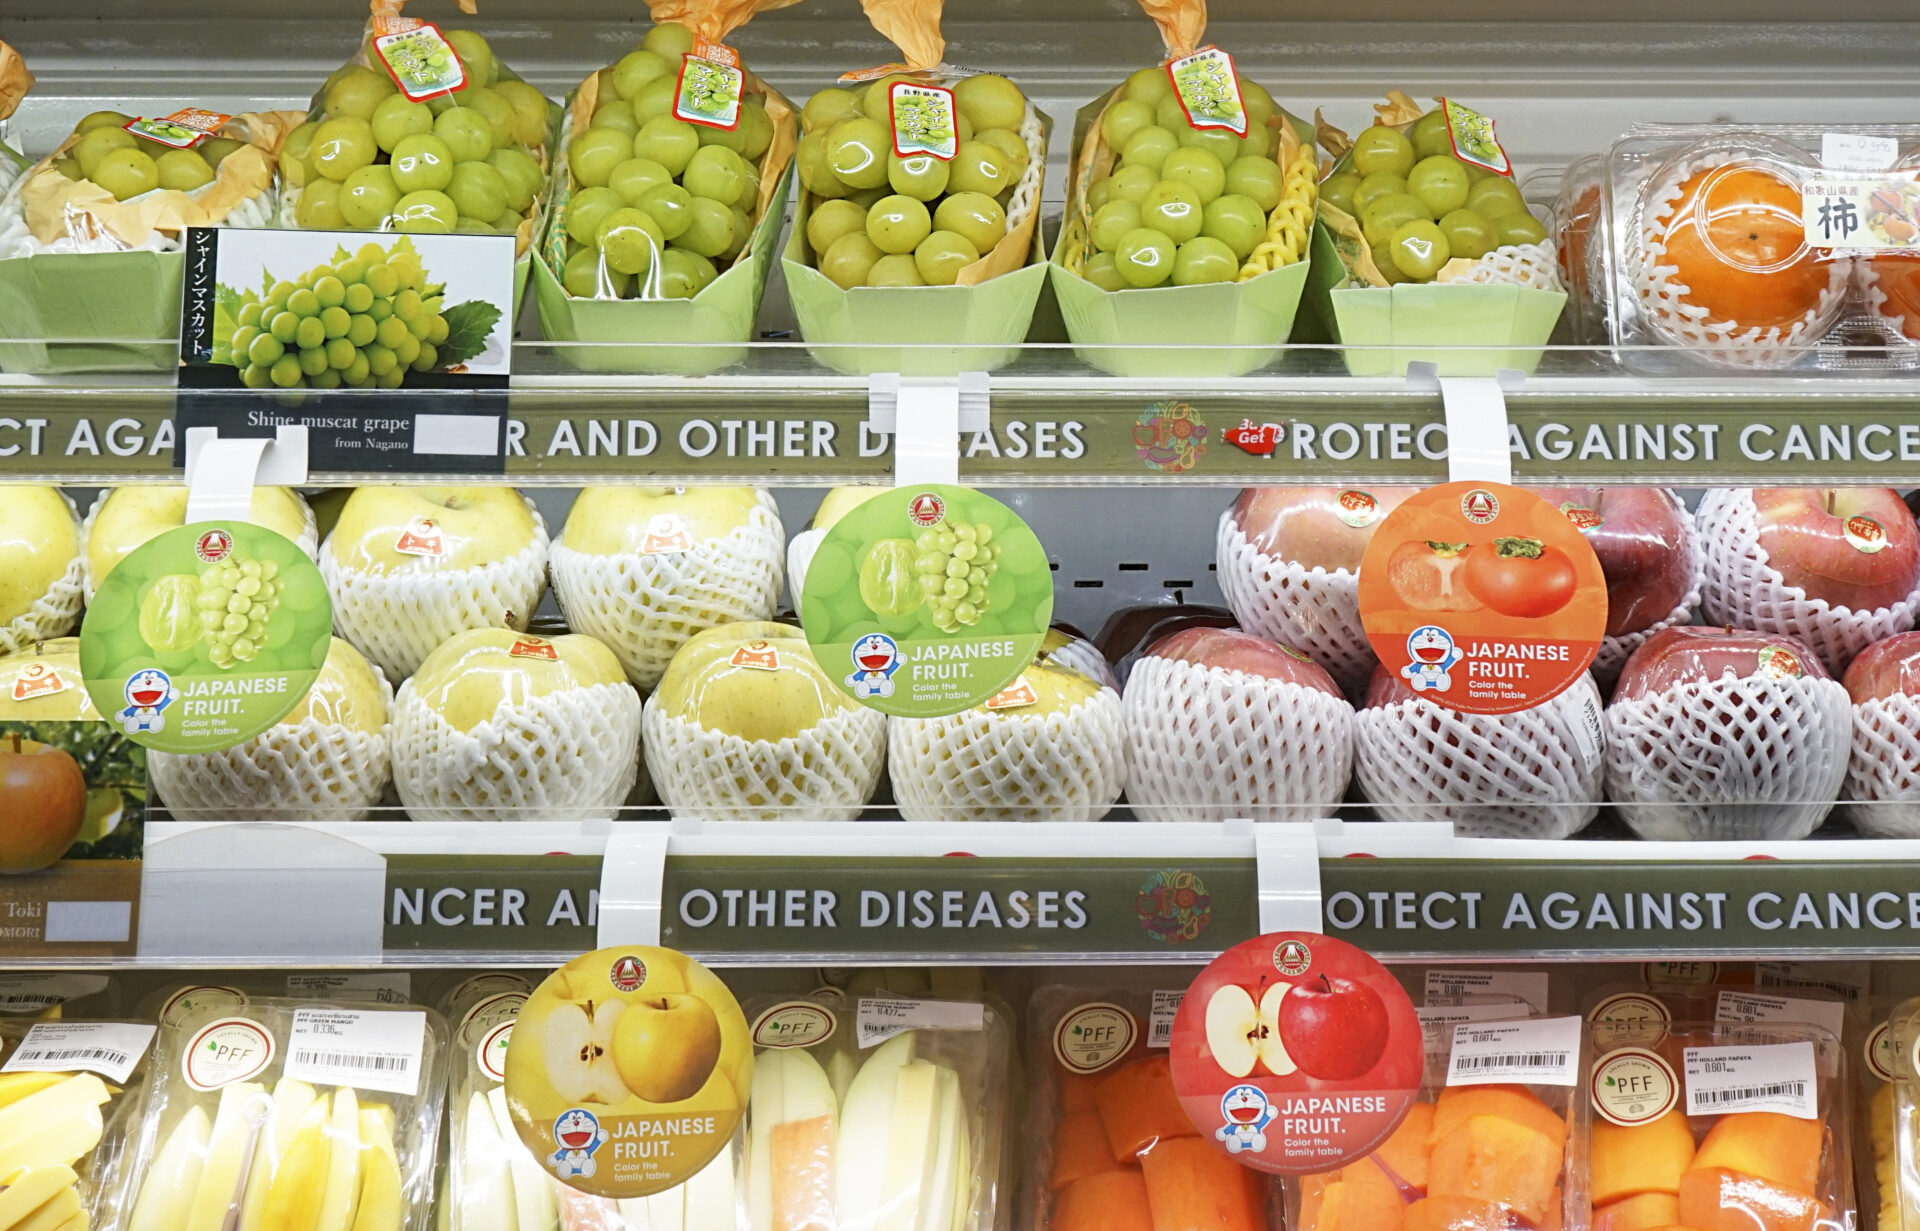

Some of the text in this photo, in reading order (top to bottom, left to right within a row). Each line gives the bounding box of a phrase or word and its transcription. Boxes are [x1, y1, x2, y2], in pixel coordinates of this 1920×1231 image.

[1805, 186, 1860, 196] 和歌山県産
[1817, 197, 1858, 240] 柿
[191, 231, 210, 356] シャインマスカット
[247, 411, 410, 434] Shine muscat grape
[335, 436, 409, 452] from Nagano
[547, 420, 657, 457] AND
[679, 419, 836, 458] OTHER
[1238, 432, 1264, 444] Get
[1508, 423, 1719, 461] AGAINST
[1739, 423, 1920, 462] CANCE
[910, 641, 1014, 662] JAPANESE
[1466, 642, 1569, 661] JAPANESE
[912, 662, 974, 681] FRUIT.
[1468, 661, 1530, 679] FRUIT.
[183, 677, 288, 697] JAPANESE
[912, 683, 957, 691] Color the
[1468, 680, 1514, 690] Color the
[912, 691, 970, 702] family table
[1469, 690, 1526, 701] family table
[183, 699, 245, 716] FRUIT.
[182, 718, 227, 728] Color the
[182, 727, 239, 738] family table
[4, 902, 41, 918] Toki
[679, 889, 837, 928] OTHER
[860, 890, 1088, 929] DISEASES
[1326, 891, 1481, 930] OTECT
[1502, 892, 1726, 930] AGAINST
[1668, 962, 1699, 976] PFF
[780, 1022, 815, 1035] PFF
[1082, 1026, 1117, 1042] PFF
[214, 1045, 253, 1062] PFF
[1617, 1076, 1652, 1094] PFF
[1281, 1097, 1386, 1115] JAPANESE
[612, 1118, 715, 1138] JAPANESE
[1284, 1116, 1346, 1135] FRUIT.
[614, 1139, 675, 1159] FRUIT.
[1284, 1138, 1329, 1147] Color the
[1284, 1146, 1343, 1158] family table
[614, 1162, 658, 1172] Color the
[614, 1171, 671, 1183] family table
